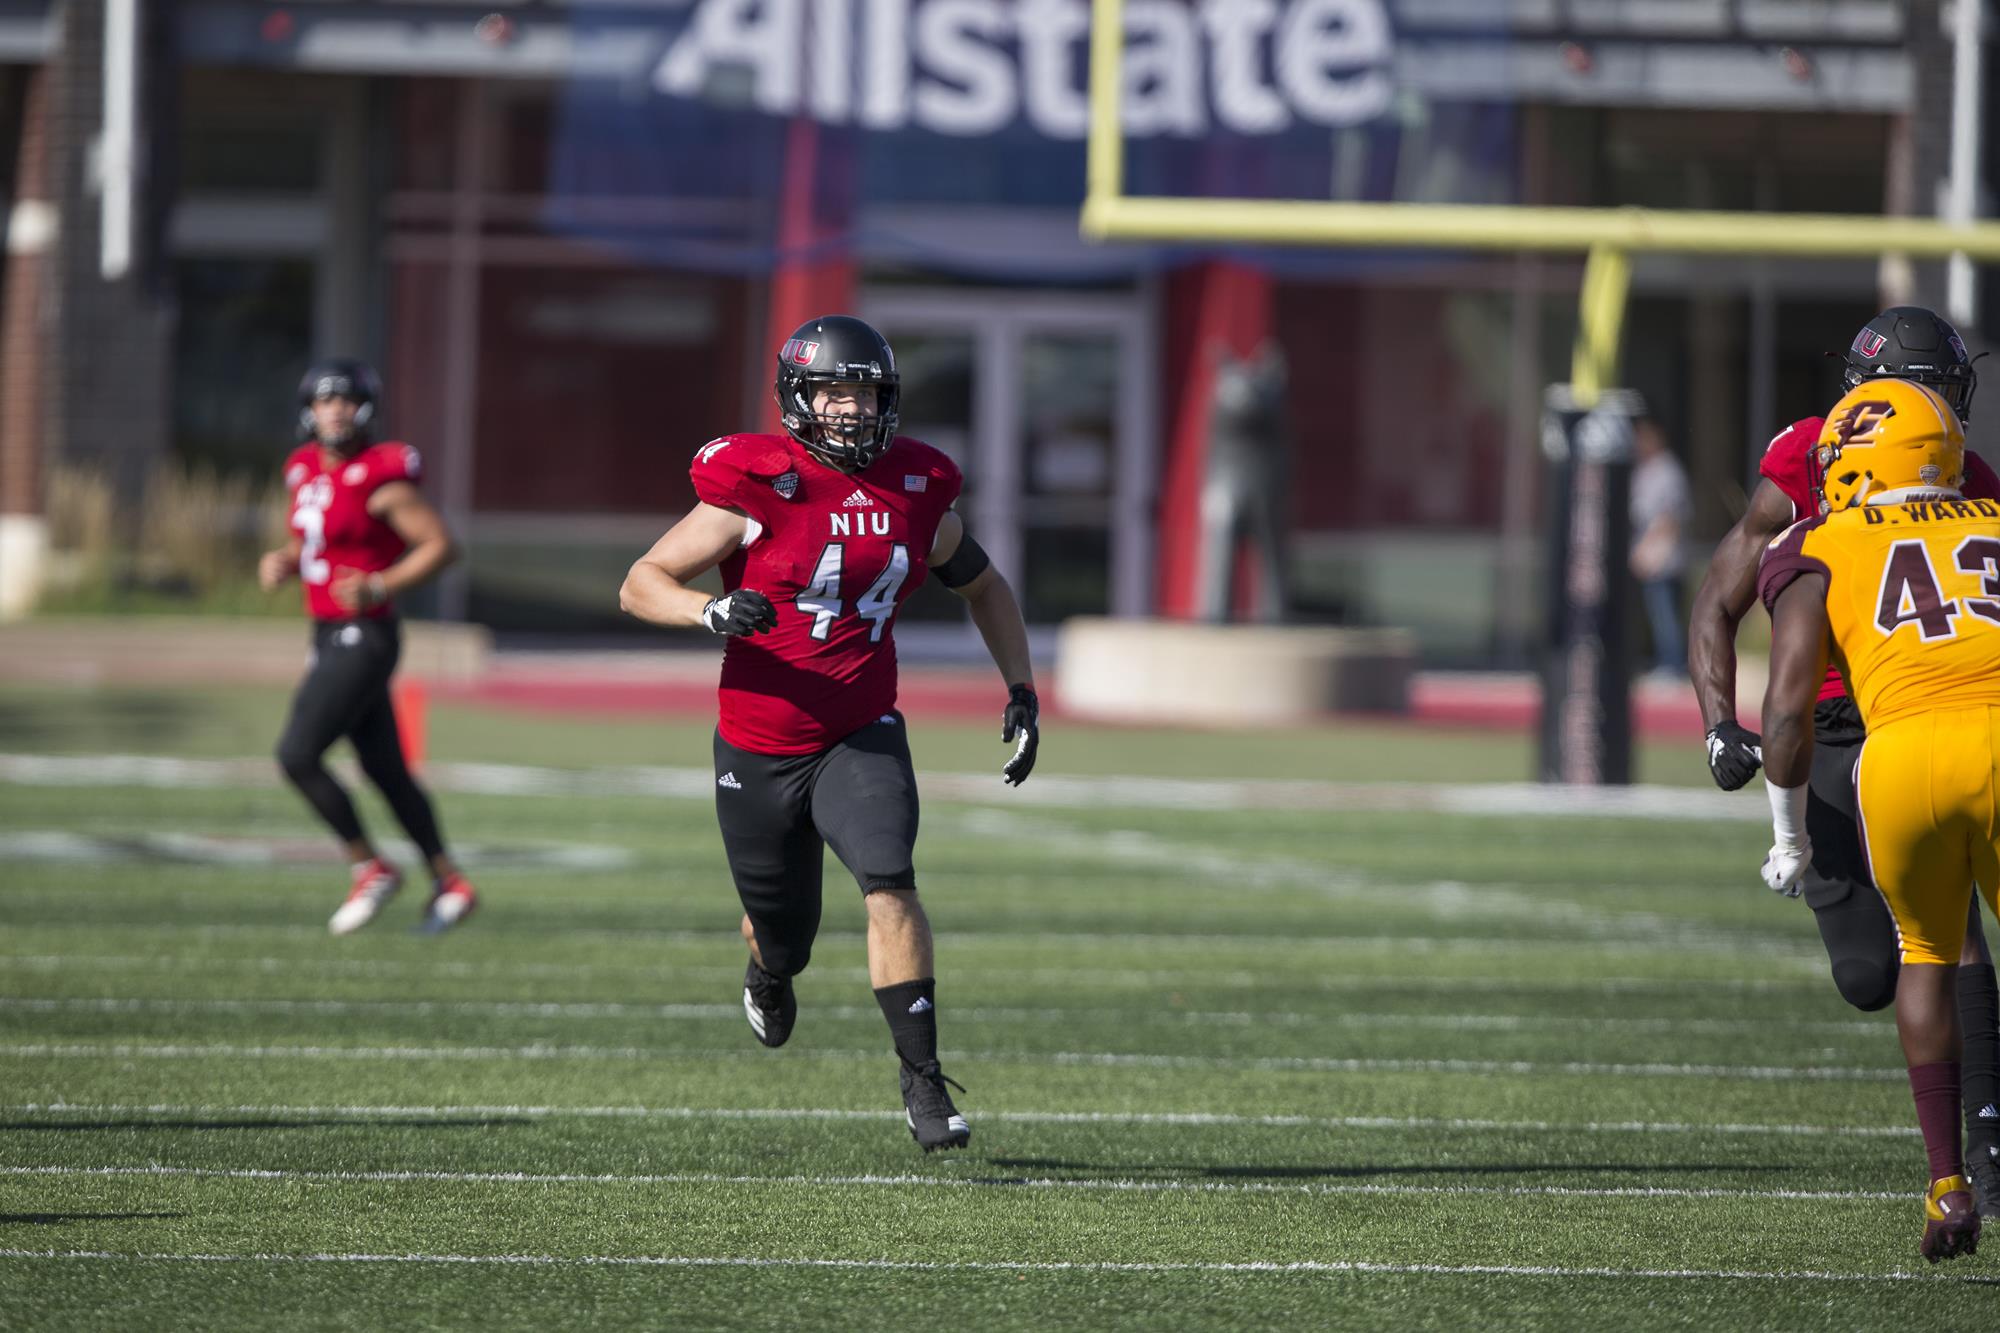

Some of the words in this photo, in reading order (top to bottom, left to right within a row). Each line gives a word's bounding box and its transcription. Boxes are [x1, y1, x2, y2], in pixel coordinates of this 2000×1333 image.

[655, 0, 1392, 137] Allstate
[830, 512, 890, 536] NIU
[842, 499, 874, 507] adidas
[1863, 508, 1899, 524] D.
[1901, 500, 1998, 522] WARD
[794, 542, 909, 643] 44
[1873, 535, 2000, 642] 43
